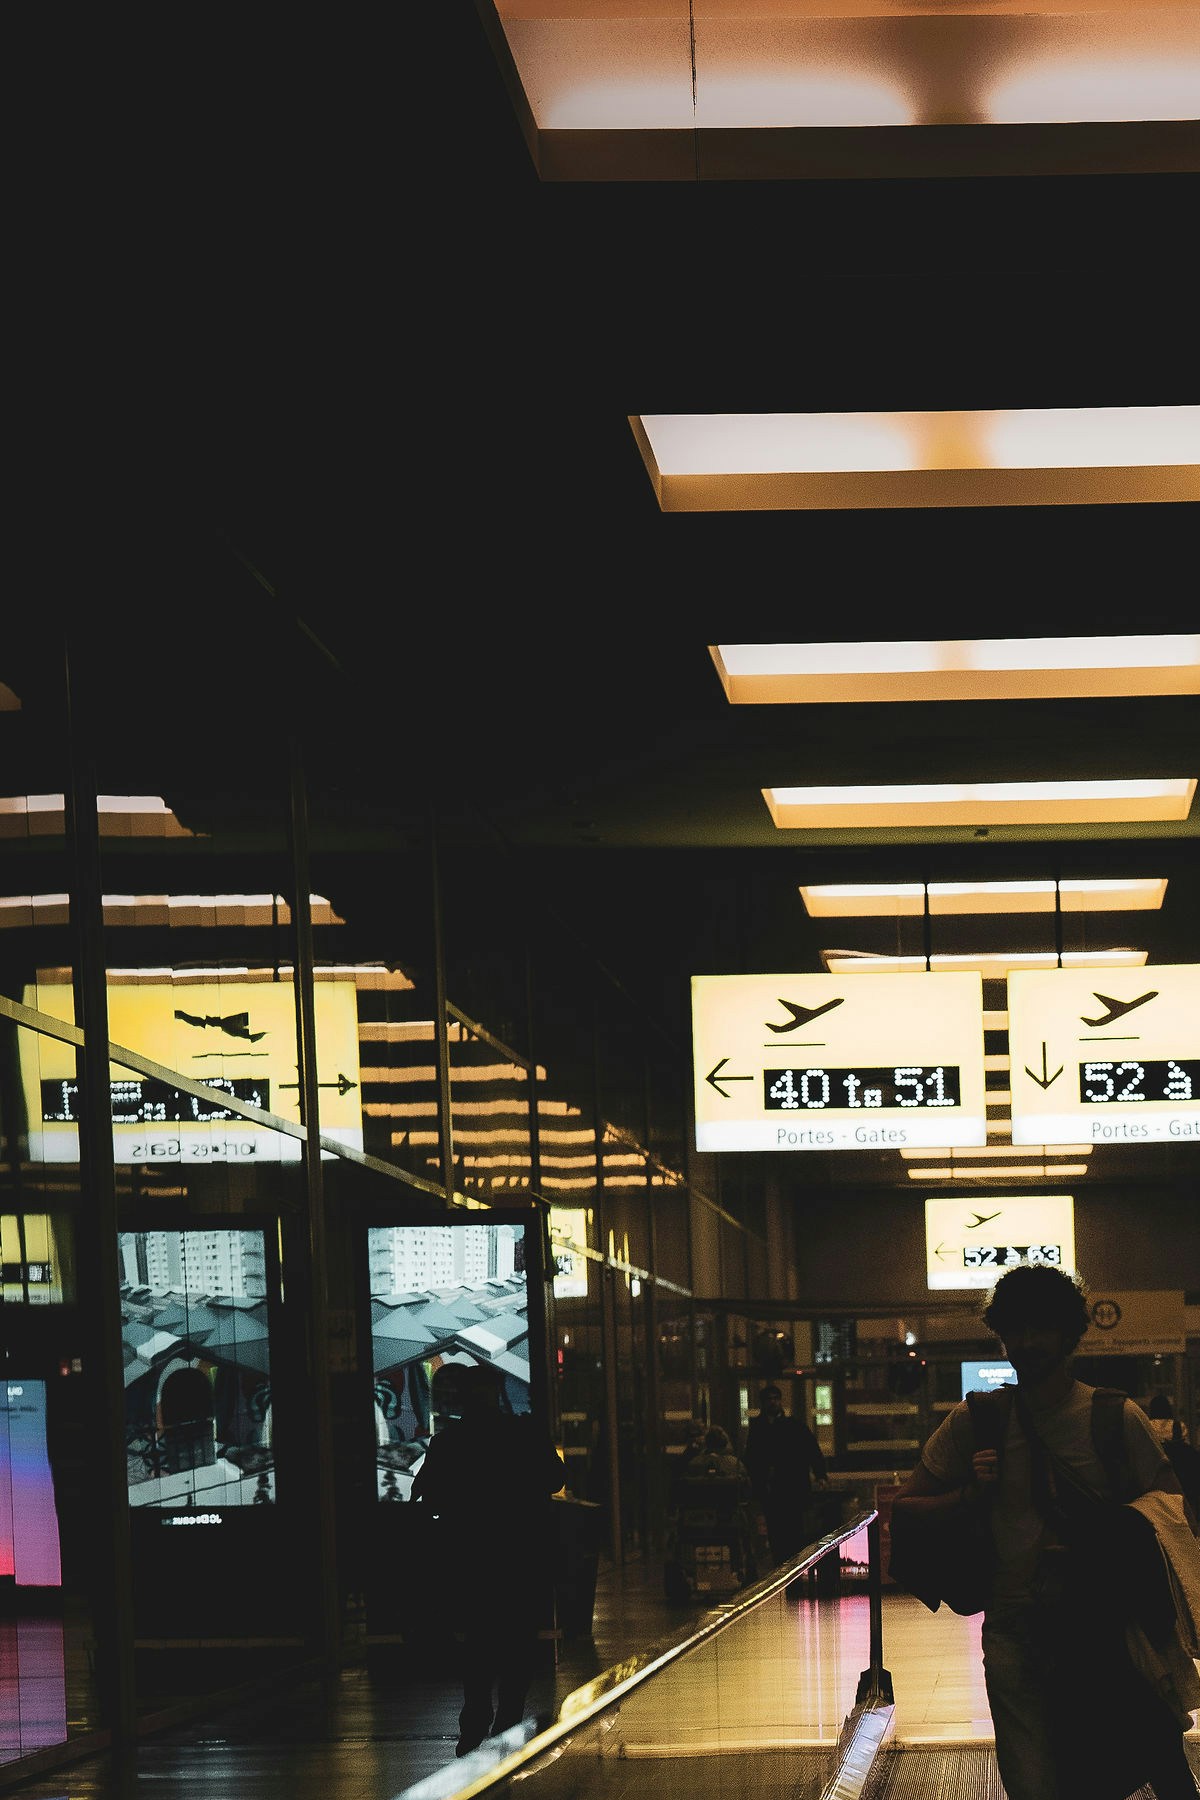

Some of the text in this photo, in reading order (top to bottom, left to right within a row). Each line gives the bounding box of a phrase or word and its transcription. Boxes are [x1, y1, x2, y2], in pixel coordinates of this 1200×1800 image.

[770, 1066, 955, 1109] 40 to 51
[1085, 1062, 1145, 1102] 52
[1163, 1060, 1192, 1100] à
[777, 1128, 834, 1145] Portes
[855, 1126, 907, 1143] Gates
[1092, 1122, 1148, 1138] Portes
[965, 1245, 1060, 1267] 52 à 63
